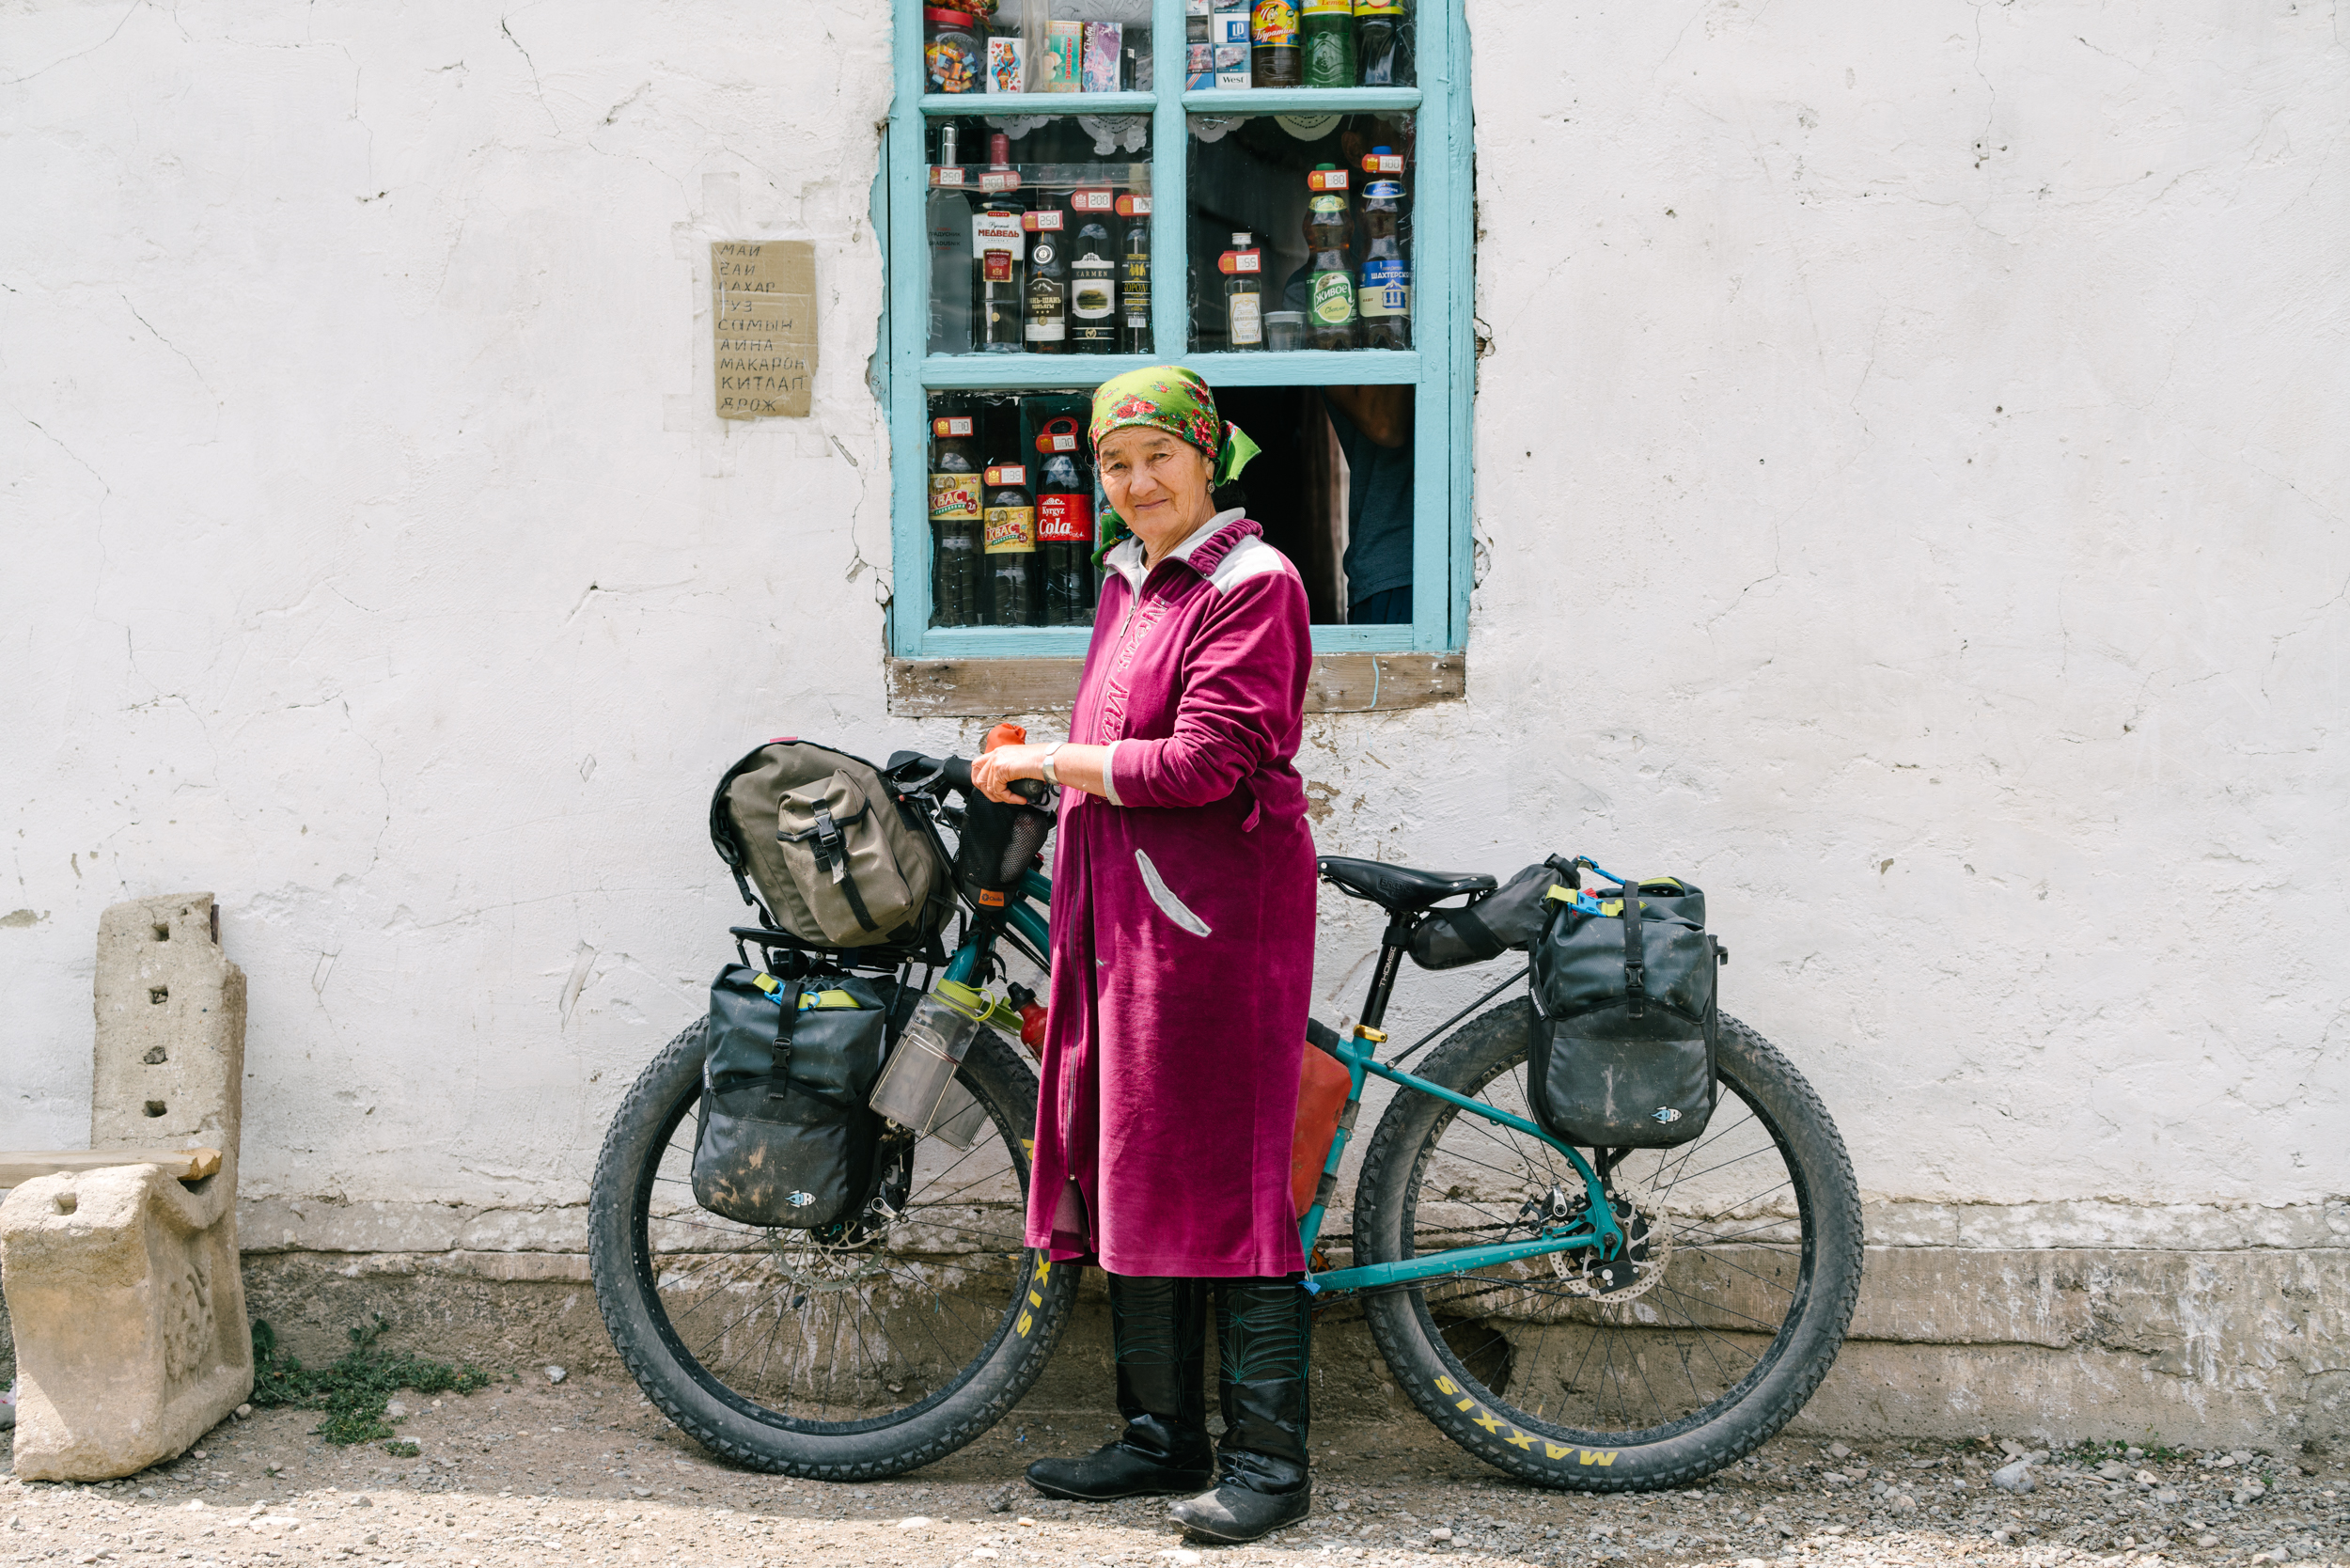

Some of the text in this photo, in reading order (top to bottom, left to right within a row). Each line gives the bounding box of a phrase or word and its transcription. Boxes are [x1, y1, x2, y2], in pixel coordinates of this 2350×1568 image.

[1232, 23, 1245, 37] LD
[942, 171, 961, 182] 250
[1332, 174, 1345, 185] 80
[1090, 195, 1109, 206] 200
[1040, 214, 1058, 226] 250
[978, 228, 1020, 238] МЕДВЕДЬ
[1244, 257, 1257, 268] 55
[719, 280, 776, 293] САХАР
[720, 357, 805, 371] МАКАРОН
[720, 398, 777, 412] ДРОЖ
[929, 491, 964, 509] КВАС
[1042, 507, 1065, 516] Kyrgyz
[988, 524, 1017, 539] КВАС
[1039, 518, 1072, 535] Cola
[1434, 1375, 1619, 1466] MAXXIS
